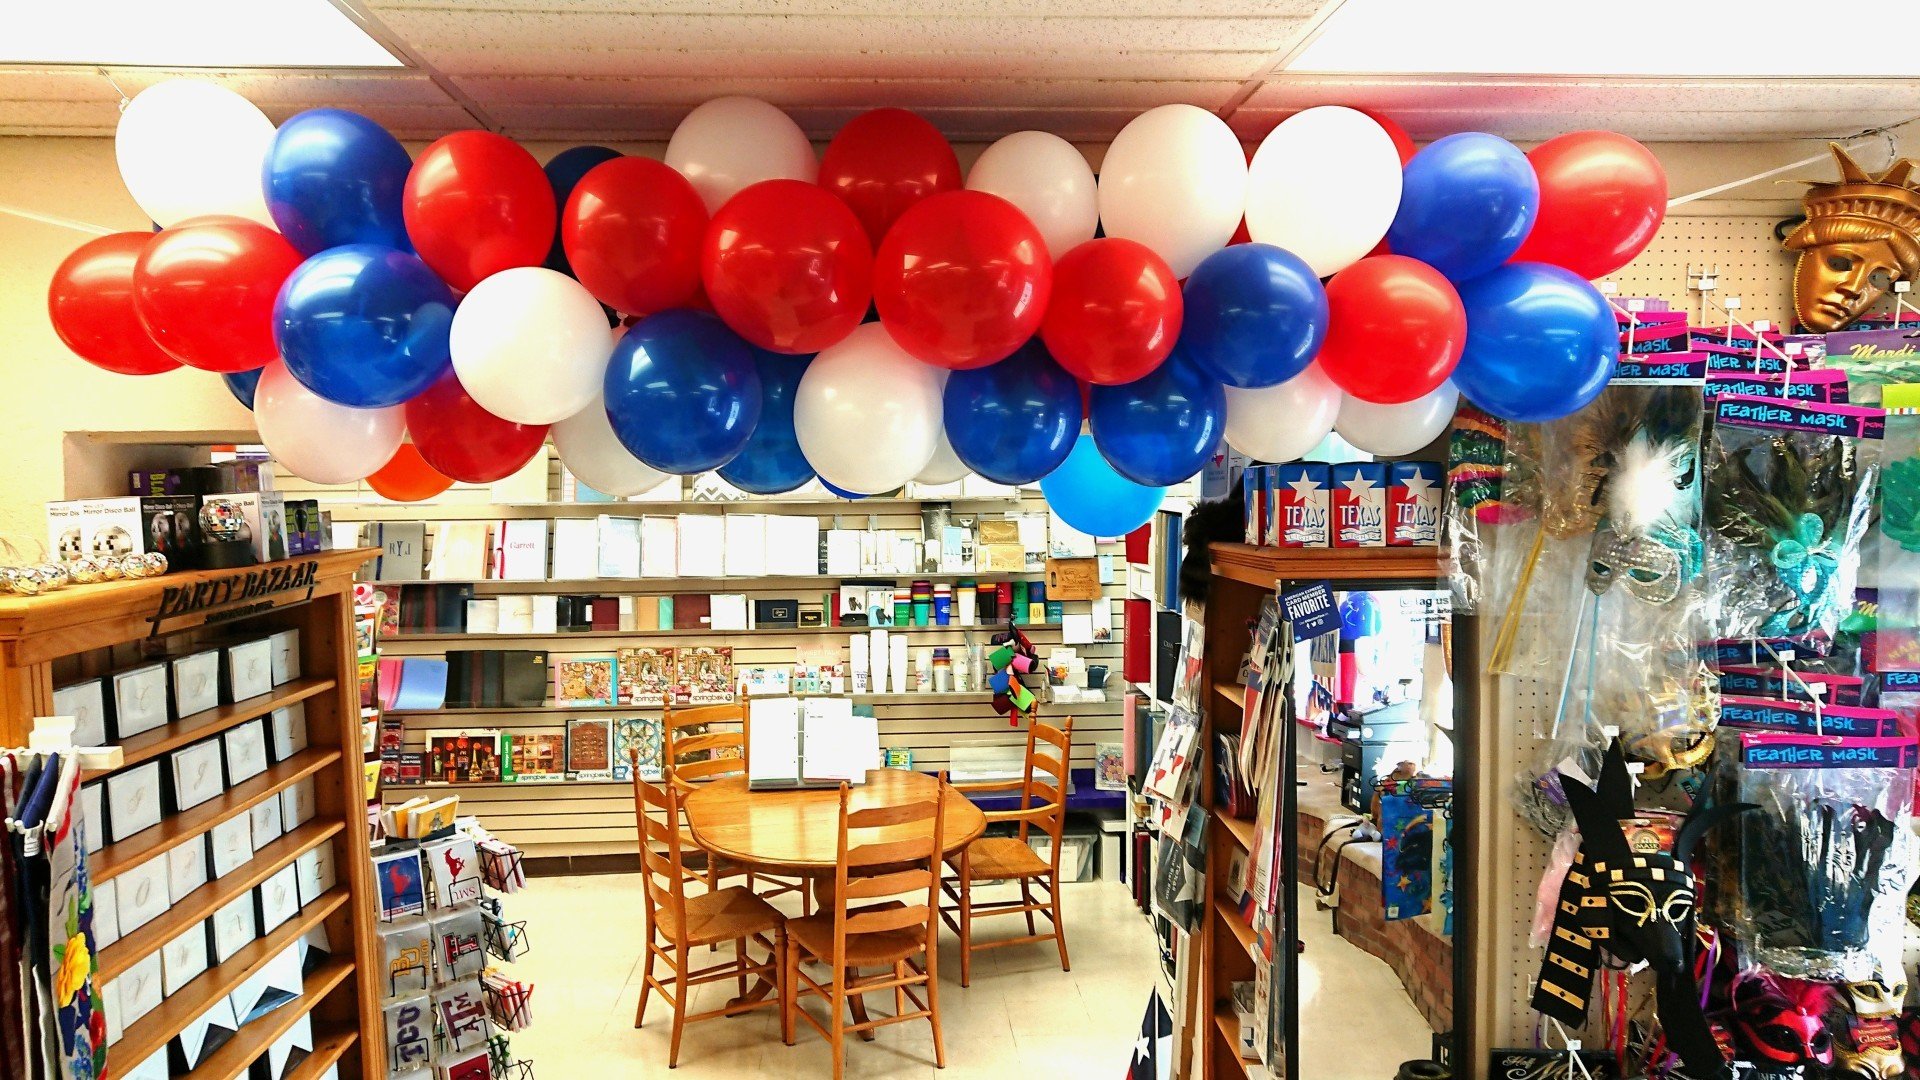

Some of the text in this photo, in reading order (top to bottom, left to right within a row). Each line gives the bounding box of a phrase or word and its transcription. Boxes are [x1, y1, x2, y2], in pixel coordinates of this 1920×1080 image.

[1849, 342, 1917, 360] Mardi
[1285, 505, 1325, 528] TEXAS
[1339, 505, 1380, 527] TEXAS
[1396, 502, 1437, 526] TEXAS
[152, 575, 241, 622] PARTY
[239, 561, 319, 599] BAZAAR
[1286, 588, 1326, 607] CARD MEMBER
[1287, 594, 1331, 620] FAVORITE
[692, 693, 724, 704] springbok
[396, 1004, 425, 1063] TCU
[1859, 1034, 1894, 1045] Glasses
